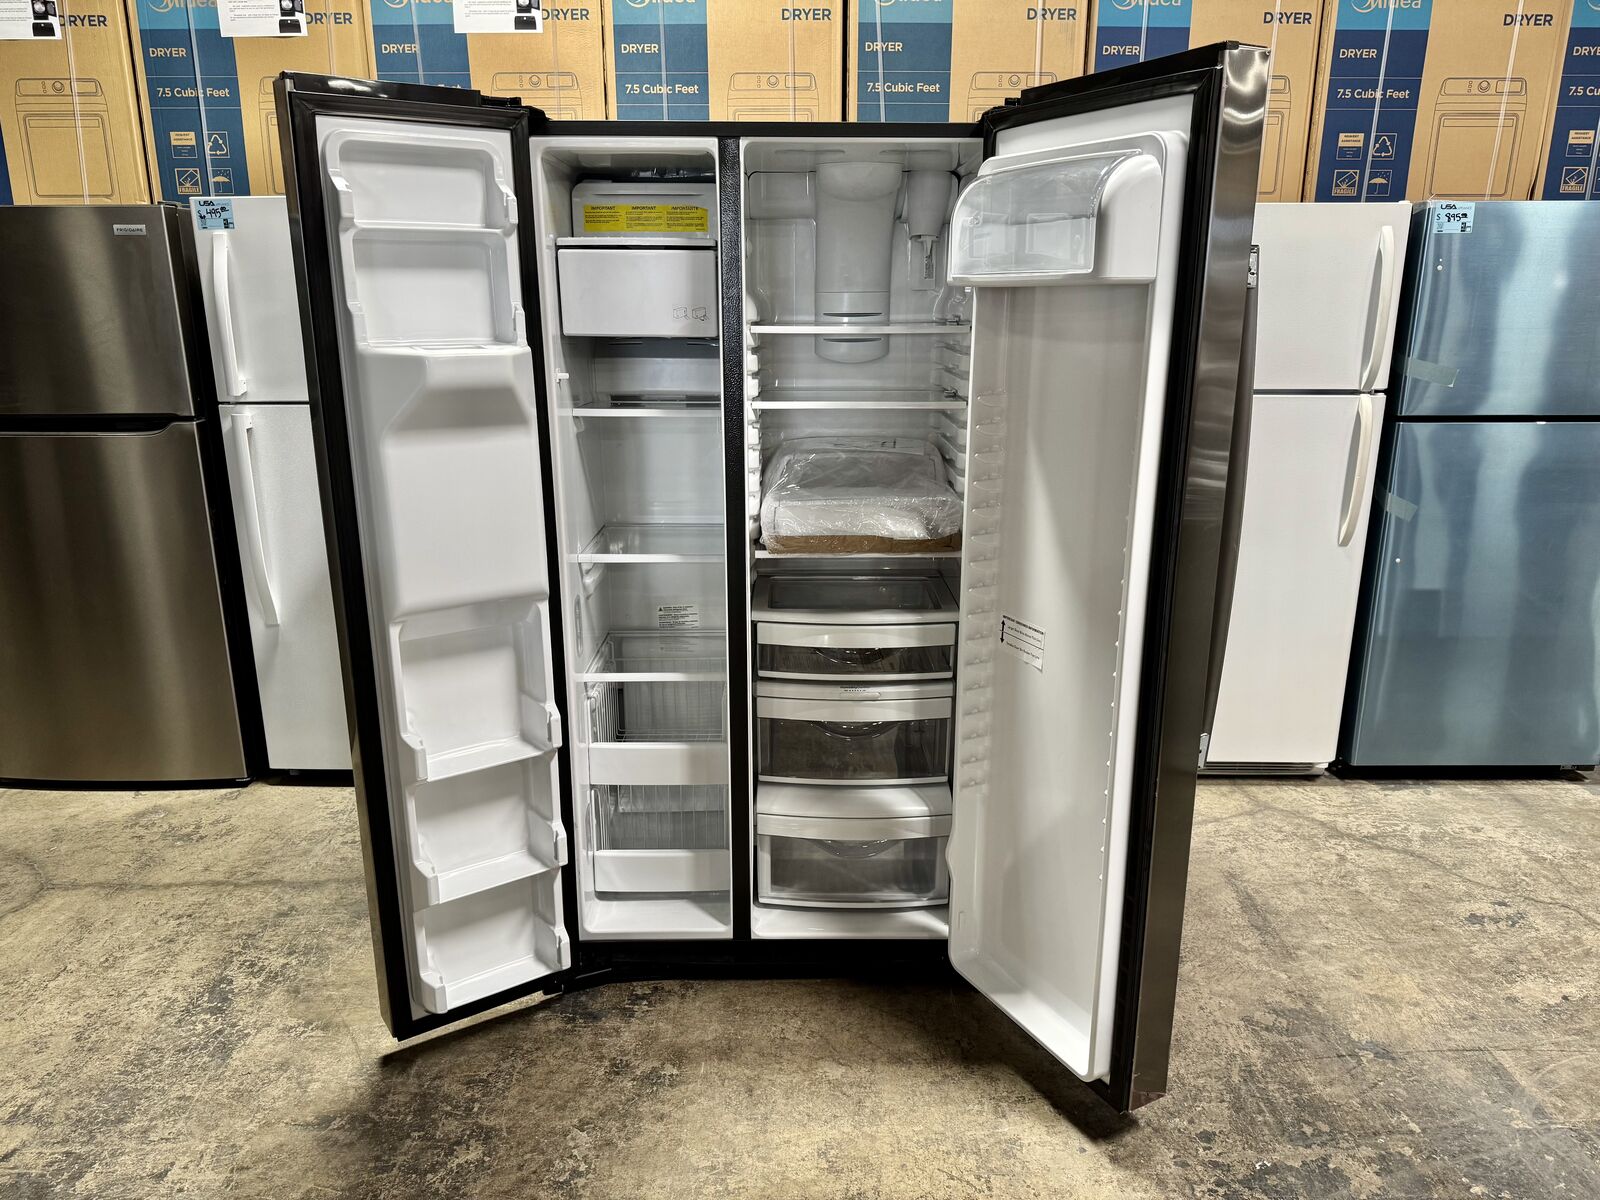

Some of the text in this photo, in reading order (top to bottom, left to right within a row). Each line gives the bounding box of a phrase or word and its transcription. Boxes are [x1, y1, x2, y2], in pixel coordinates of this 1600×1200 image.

[781, 9, 831, 20] DRYER
[1027, 8, 1077, 20] DRYER
[1263, 12, 1312, 24] DRYER
[1503, 14, 1553, 26] DRYER
[621, 44, 659, 53] DRYER
[865, 42, 903, 52] DRYER
[1102, 45, 1140, 55] DRYER
[149, 48, 187, 57] DRYER
[1339, 48, 1377, 58] DRYER
[156, 87, 171, 97] 7.5
[206, 88, 230, 97] Feet
[625, 84, 640, 94] 7.5
[675, 84, 699, 94] Feet
[866, 83, 940, 93] 7.5 Cubic Feet
[1568, 86, 1584, 96] 7.5
[1336, 88, 1352, 99] 7.5
[1386, 89, 1410, 99] Feet
